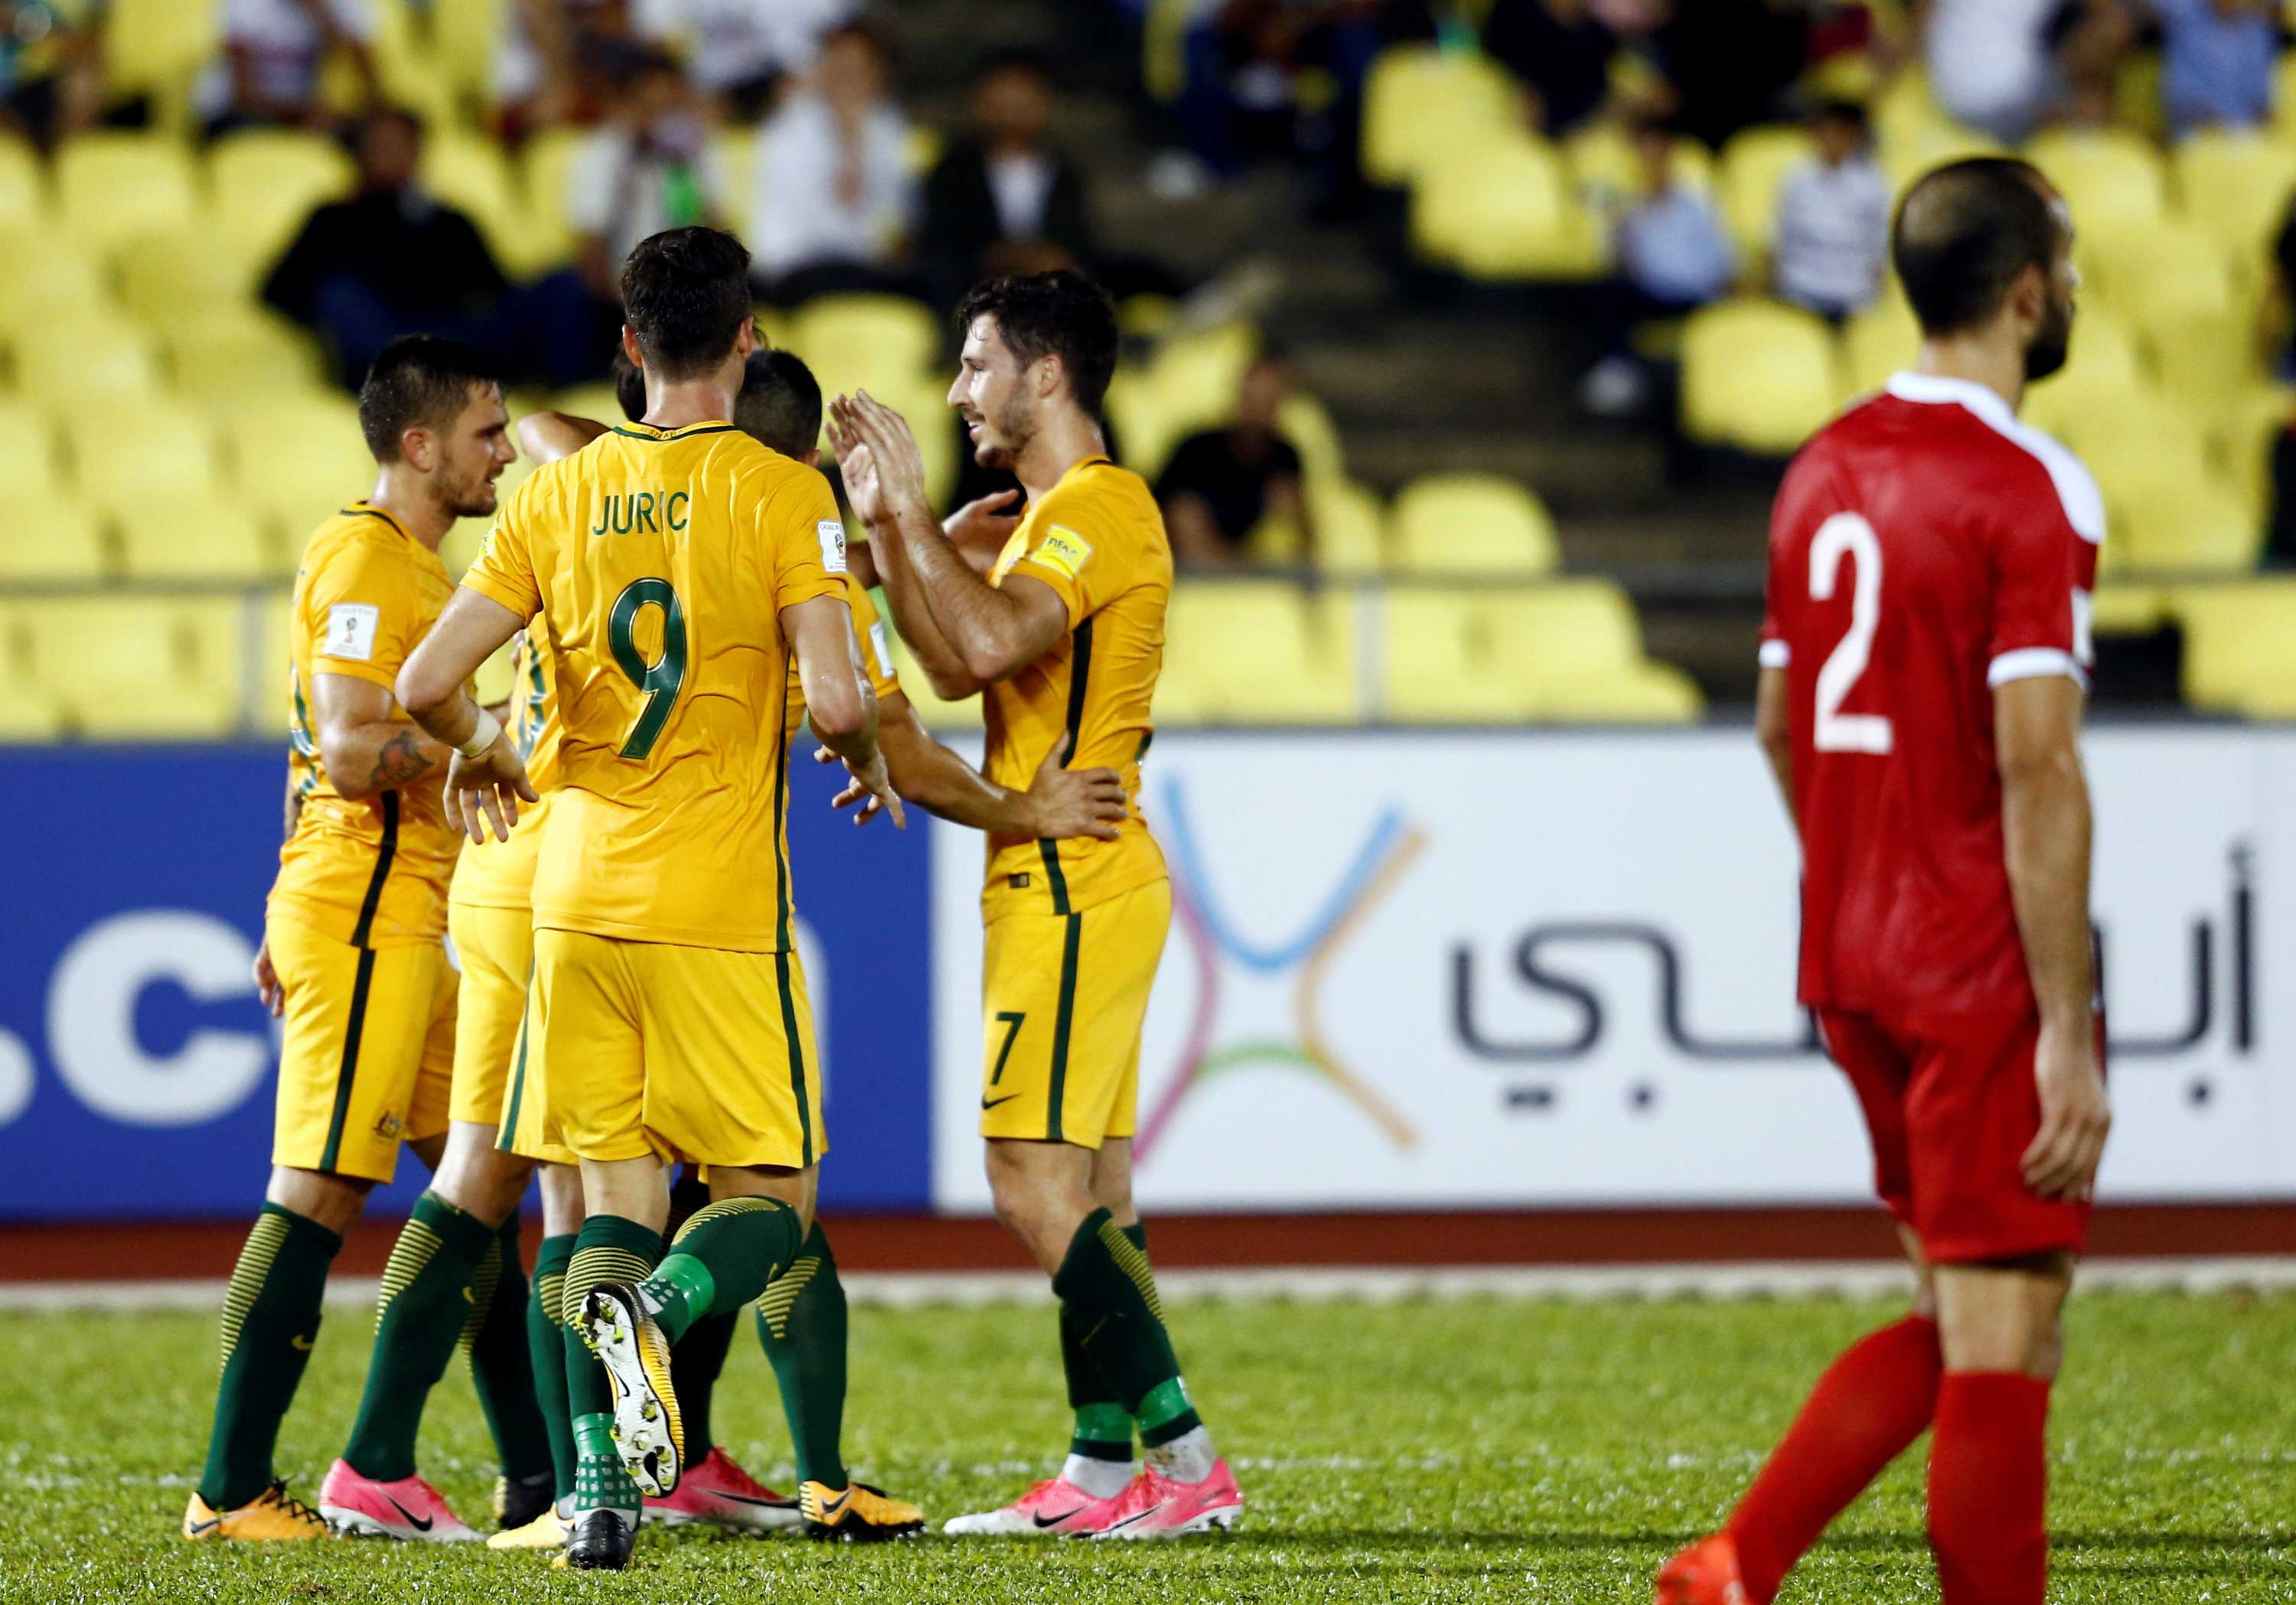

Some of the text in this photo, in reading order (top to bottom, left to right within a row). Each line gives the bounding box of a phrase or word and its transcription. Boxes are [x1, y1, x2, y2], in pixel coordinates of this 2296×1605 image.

[592, 491, 689, 535] JURIC
[608, 577, 687, 759] 9
[1809, 511, 1893, 755] 2
[991, 1011, 1026, 1086] 7
